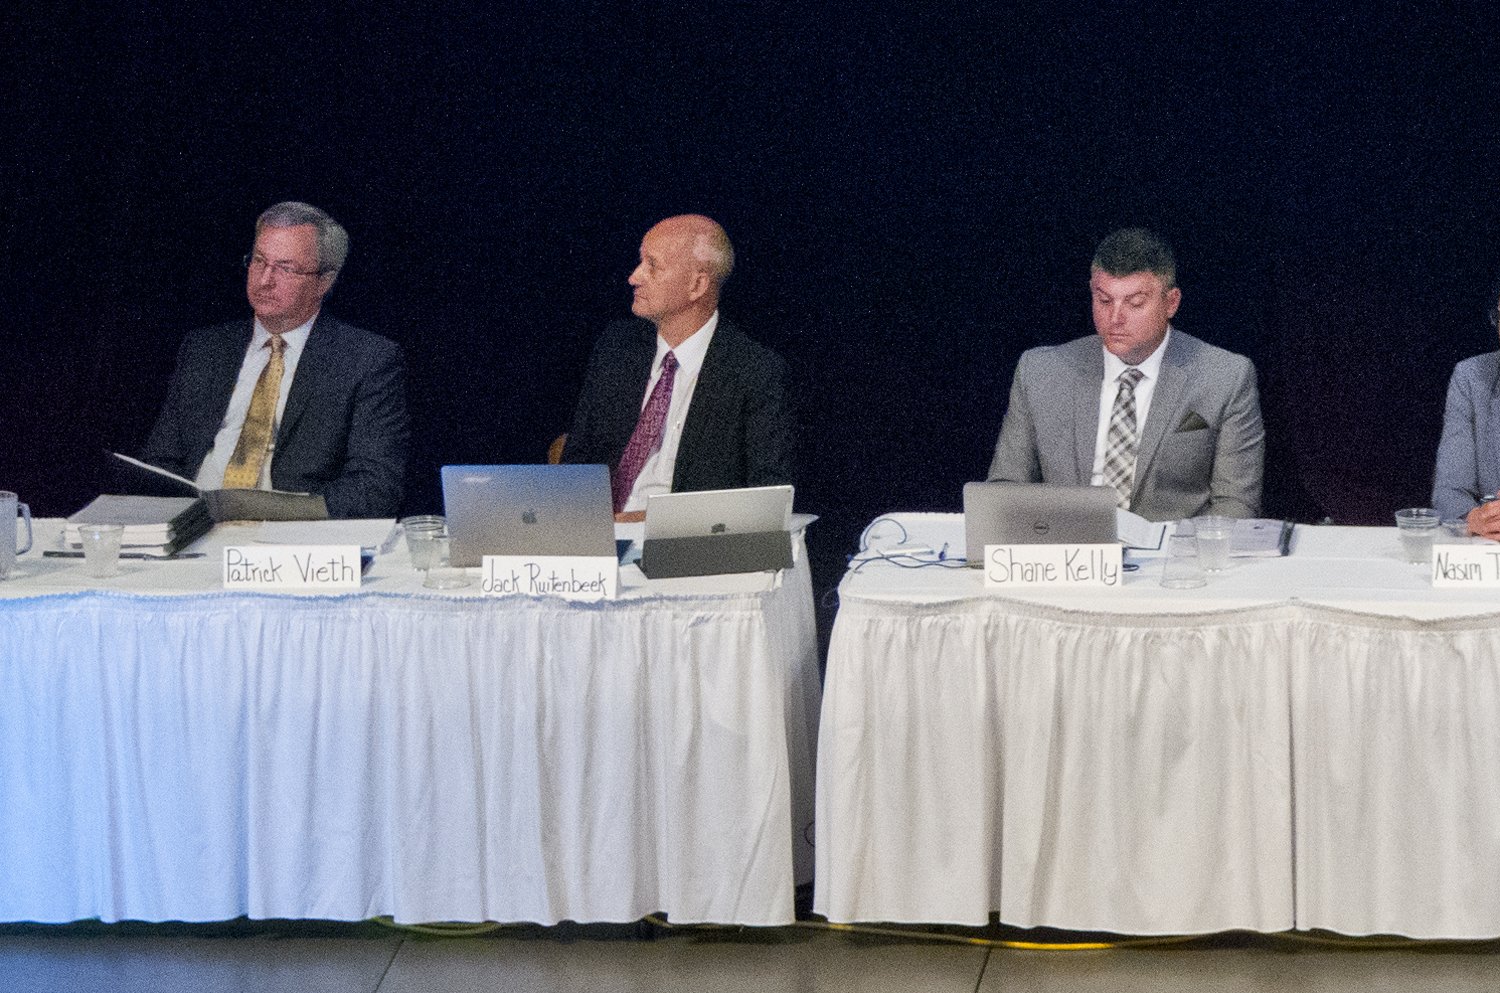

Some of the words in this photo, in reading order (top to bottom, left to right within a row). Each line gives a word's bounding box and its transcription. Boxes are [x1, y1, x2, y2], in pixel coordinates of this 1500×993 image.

[227, 548, 283, 583] Patrick
[293, 552, 354, 583] Vieth
[482, 558, 520, 593] Jack
[524, 562, 607, 596] Ruitenbeek
[989, 547, 1058, 583] Shane
[1065, 547, 1118, 586] Kelly
[1434, 552, 1482, 581] Nasim
